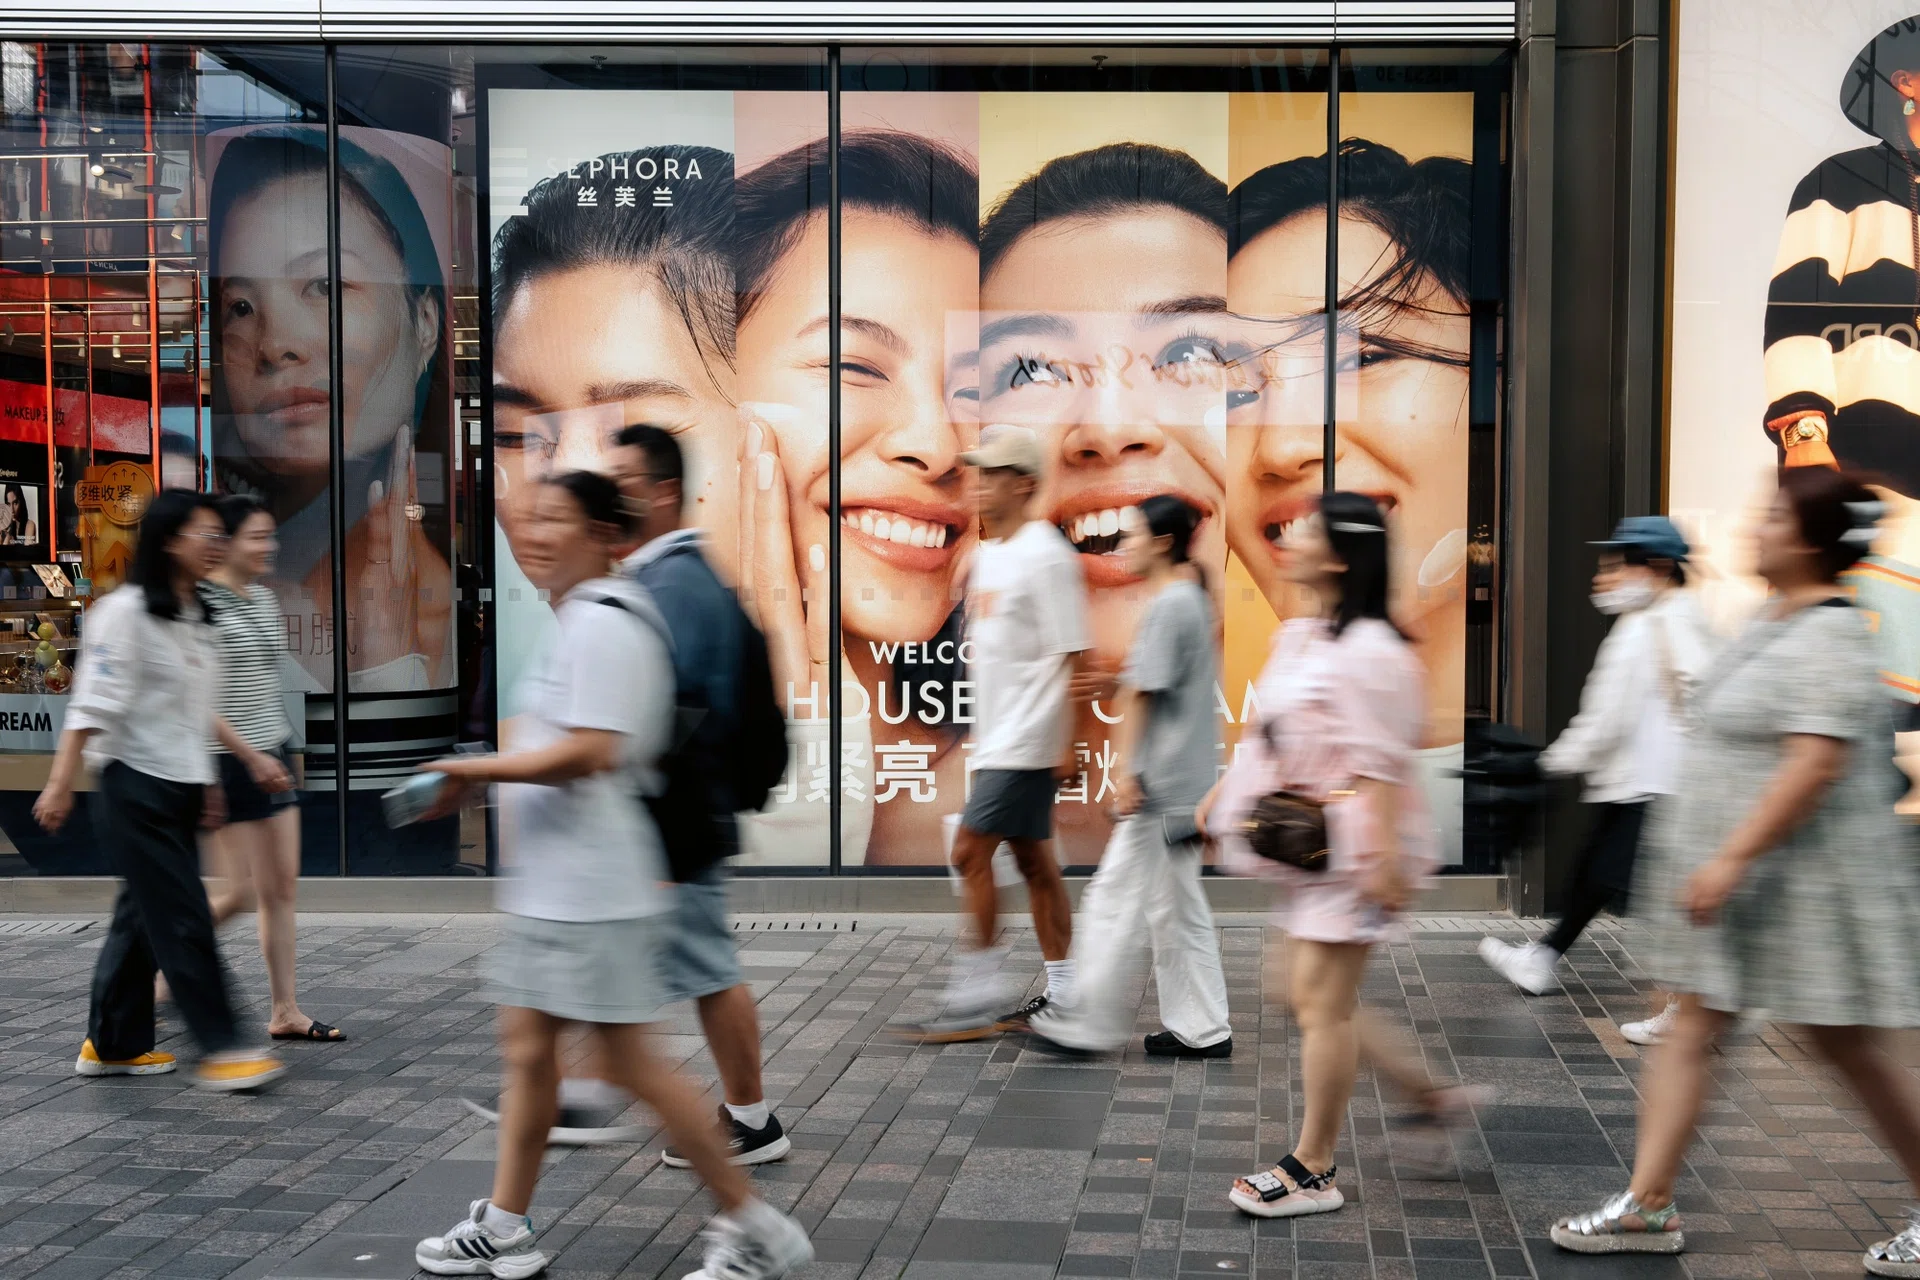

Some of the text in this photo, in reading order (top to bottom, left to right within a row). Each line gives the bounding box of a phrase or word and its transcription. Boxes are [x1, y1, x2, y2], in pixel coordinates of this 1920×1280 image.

[547, 157, 702, 179] SEPHORA
[577, 186, 673, 207] 丝芙兰
[4, 405, 41, 421] MAKEUP
[79, 485, 132, 501] 多维收紧
[787, 681, 977, 725] HOUSE
[0, 712, 53, 731] REAM
